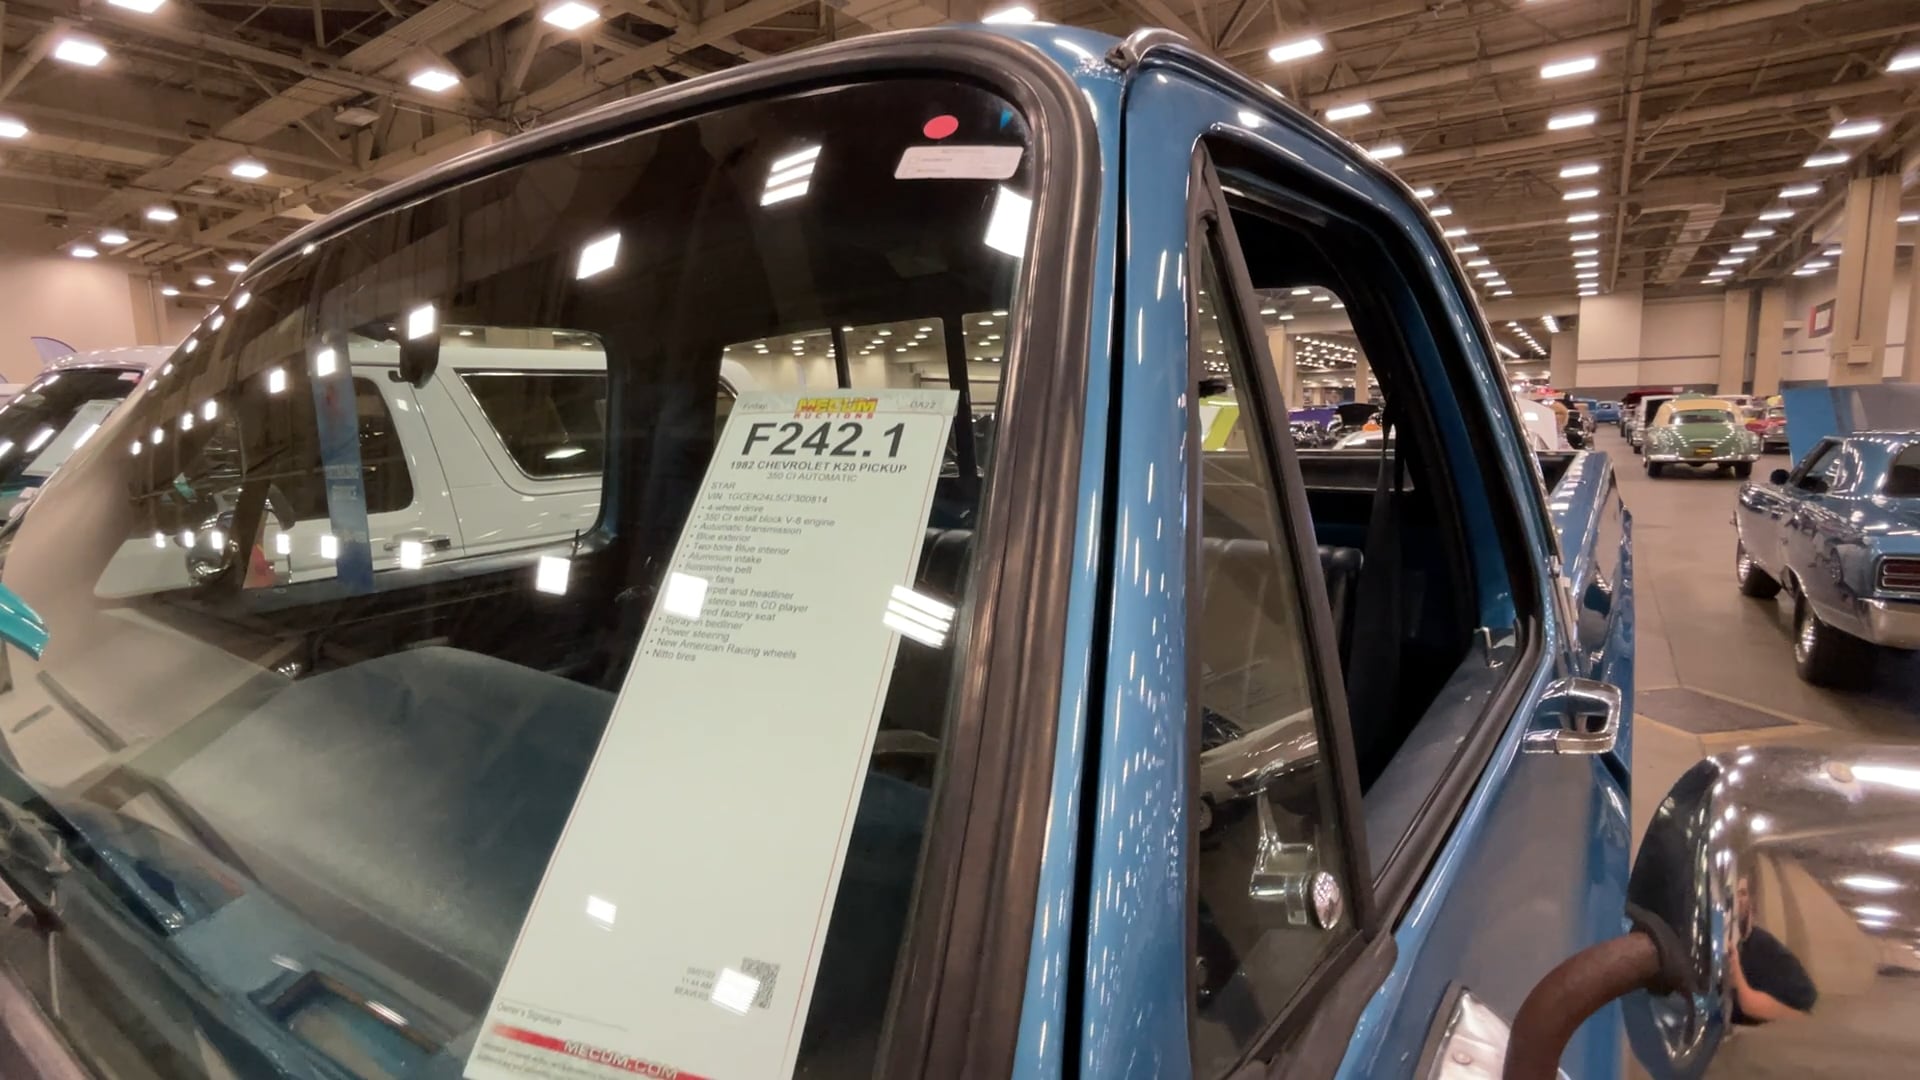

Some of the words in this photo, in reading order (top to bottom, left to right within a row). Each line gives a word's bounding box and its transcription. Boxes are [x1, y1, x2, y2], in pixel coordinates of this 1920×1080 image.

[796, 397, 879, 413] MECUM
[741, 422, 905, 458] F242.1
[730, 461, 754, 470] 1982
[757, 461, 831, 471] CHEVROLET
[833, 462, 856, 472] K20
[859, 463, 907, 473] PICKUP
[767, 472, 784, 480] 350
[785, 472, 796, 480] CI
[797, 472, 857, 482] AUTOMATIC
[742, 505, 764, 513] drive
[704, 513, 721, 521] 350
[721, 513, 732, 521] CI
[734, 514, 758, 522] small
[758, 515, 781, 523] block
[803, 518, 835, 527] engine
[700, 523, 742, 531] Automatic
[745, 524, 801, 535] transmission
[696, 532, 716, 540] Blue
[718, 533, 751, 541] exterior
[735, 543, 756, 553] Blue
[757, 545, 790, 555] interior
[688, 552, 732, 562] Aluminum
[734, 554, 762, 563] intake
[734, 565, 752, 574] belt
[715, 574, 735, 584] fans
[729, 588, 748, 597] and
[749, 588, 794, 600] headliner
[708, 597, 737, 607] stereo
[739, 598, 759, 608] with
[760, 600, 777, 610] CD
[778, 602, 808, 613] player
[720, 608, 753, 621] factory
[755, 612, 776, 621] seat
[705, 617, 743, 630] bedliner
[660, 626, 690, 636] Power
[693, 627, 730, 642] steering
[652, 649, 674, 660] Nitto
[675, 651, 696, 662] tires
[656, 638, 677, 647] New
[679, 639, 725, 652] American
[726, 642, 760, 658] Racing
[763, 648, 797, 660] wheels
[526, 1008, 562, 1026] Signature
[563, 1040, 679, 1080] MECUM.COM
